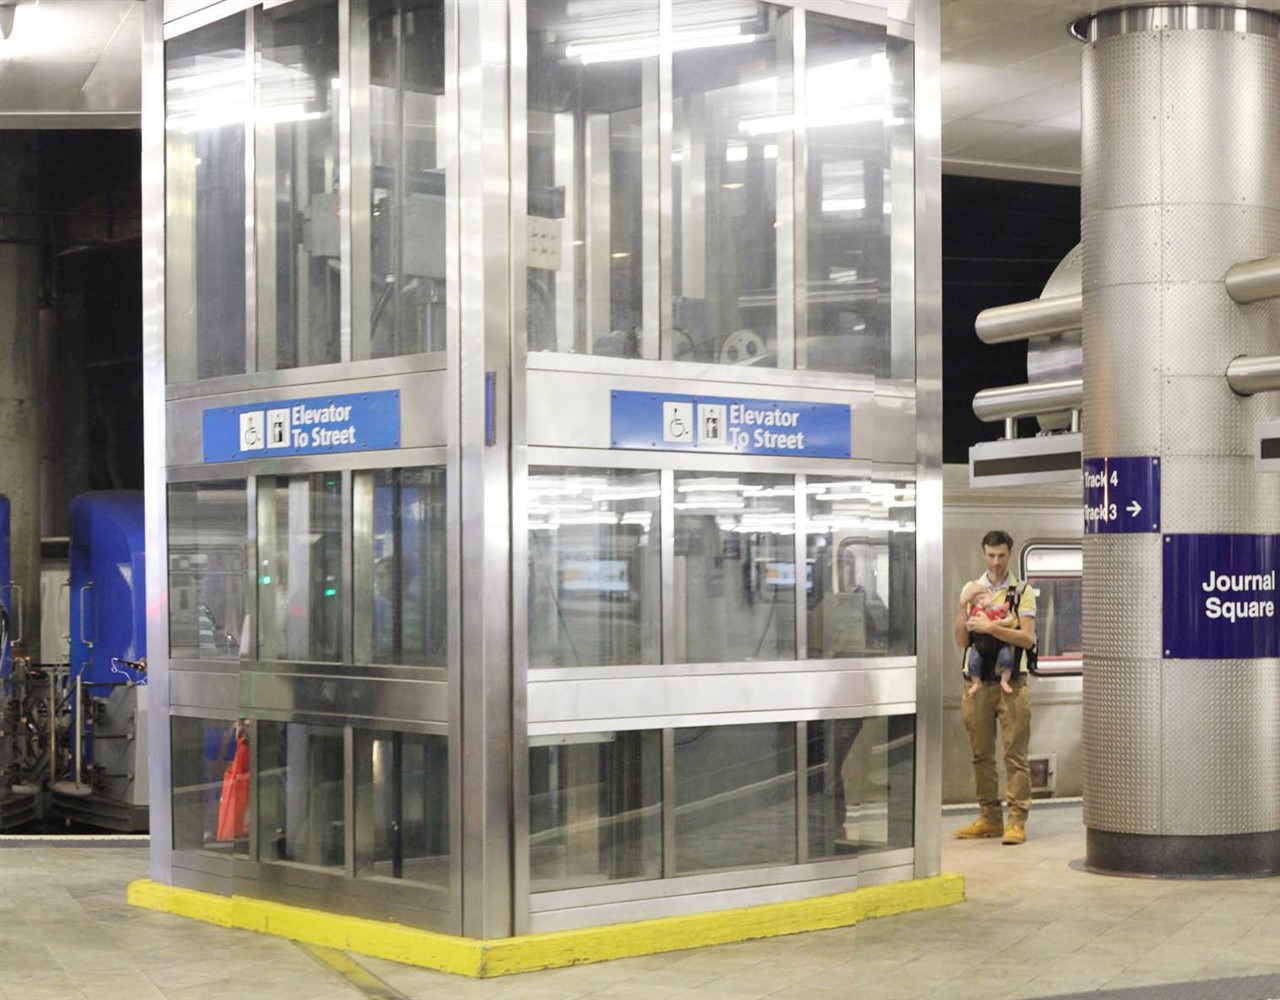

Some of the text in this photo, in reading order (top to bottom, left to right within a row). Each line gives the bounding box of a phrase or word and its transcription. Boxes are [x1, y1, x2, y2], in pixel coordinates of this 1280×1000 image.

[292, 405, 352, 426] Elevator
[729, 404, 799, 427] Elevator
[291, 425, 356, 448] To Street
[729, 427, 805, 450] To Street
[1085, 470, 1118, 488] Track 4
[1084, 503, 1117, 521] Track 3
[1202, 570, 1275, 592] Journal
[1205, 597, 1275, 623] Square
